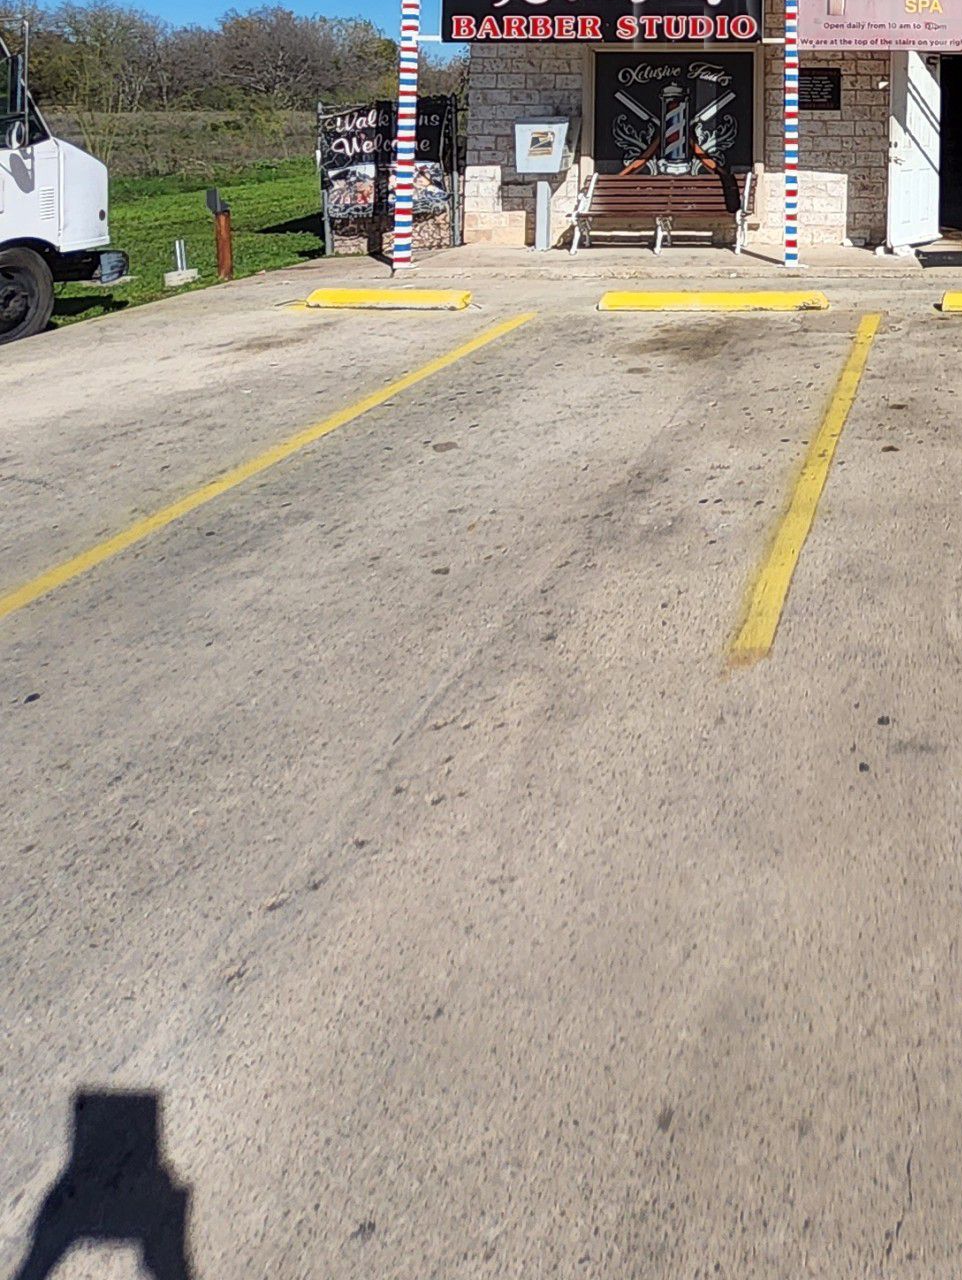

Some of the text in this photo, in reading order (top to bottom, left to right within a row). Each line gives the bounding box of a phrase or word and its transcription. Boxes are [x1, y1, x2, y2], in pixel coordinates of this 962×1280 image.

[451, 15, 758, 39] BARBER STUDIO
[823, 22, 845, 30] Open
[847, 21, 865, 30] daily
[913, 22, 921, 30] to
[840, 38, 852, 46] the
[854, 38, 868, 47] top
[881, 38, 892, 46] the
[895, 38, 916, 46] stairs
[930, 39, 947, 47] your
[618, 62, 681, 87] Xclusive
